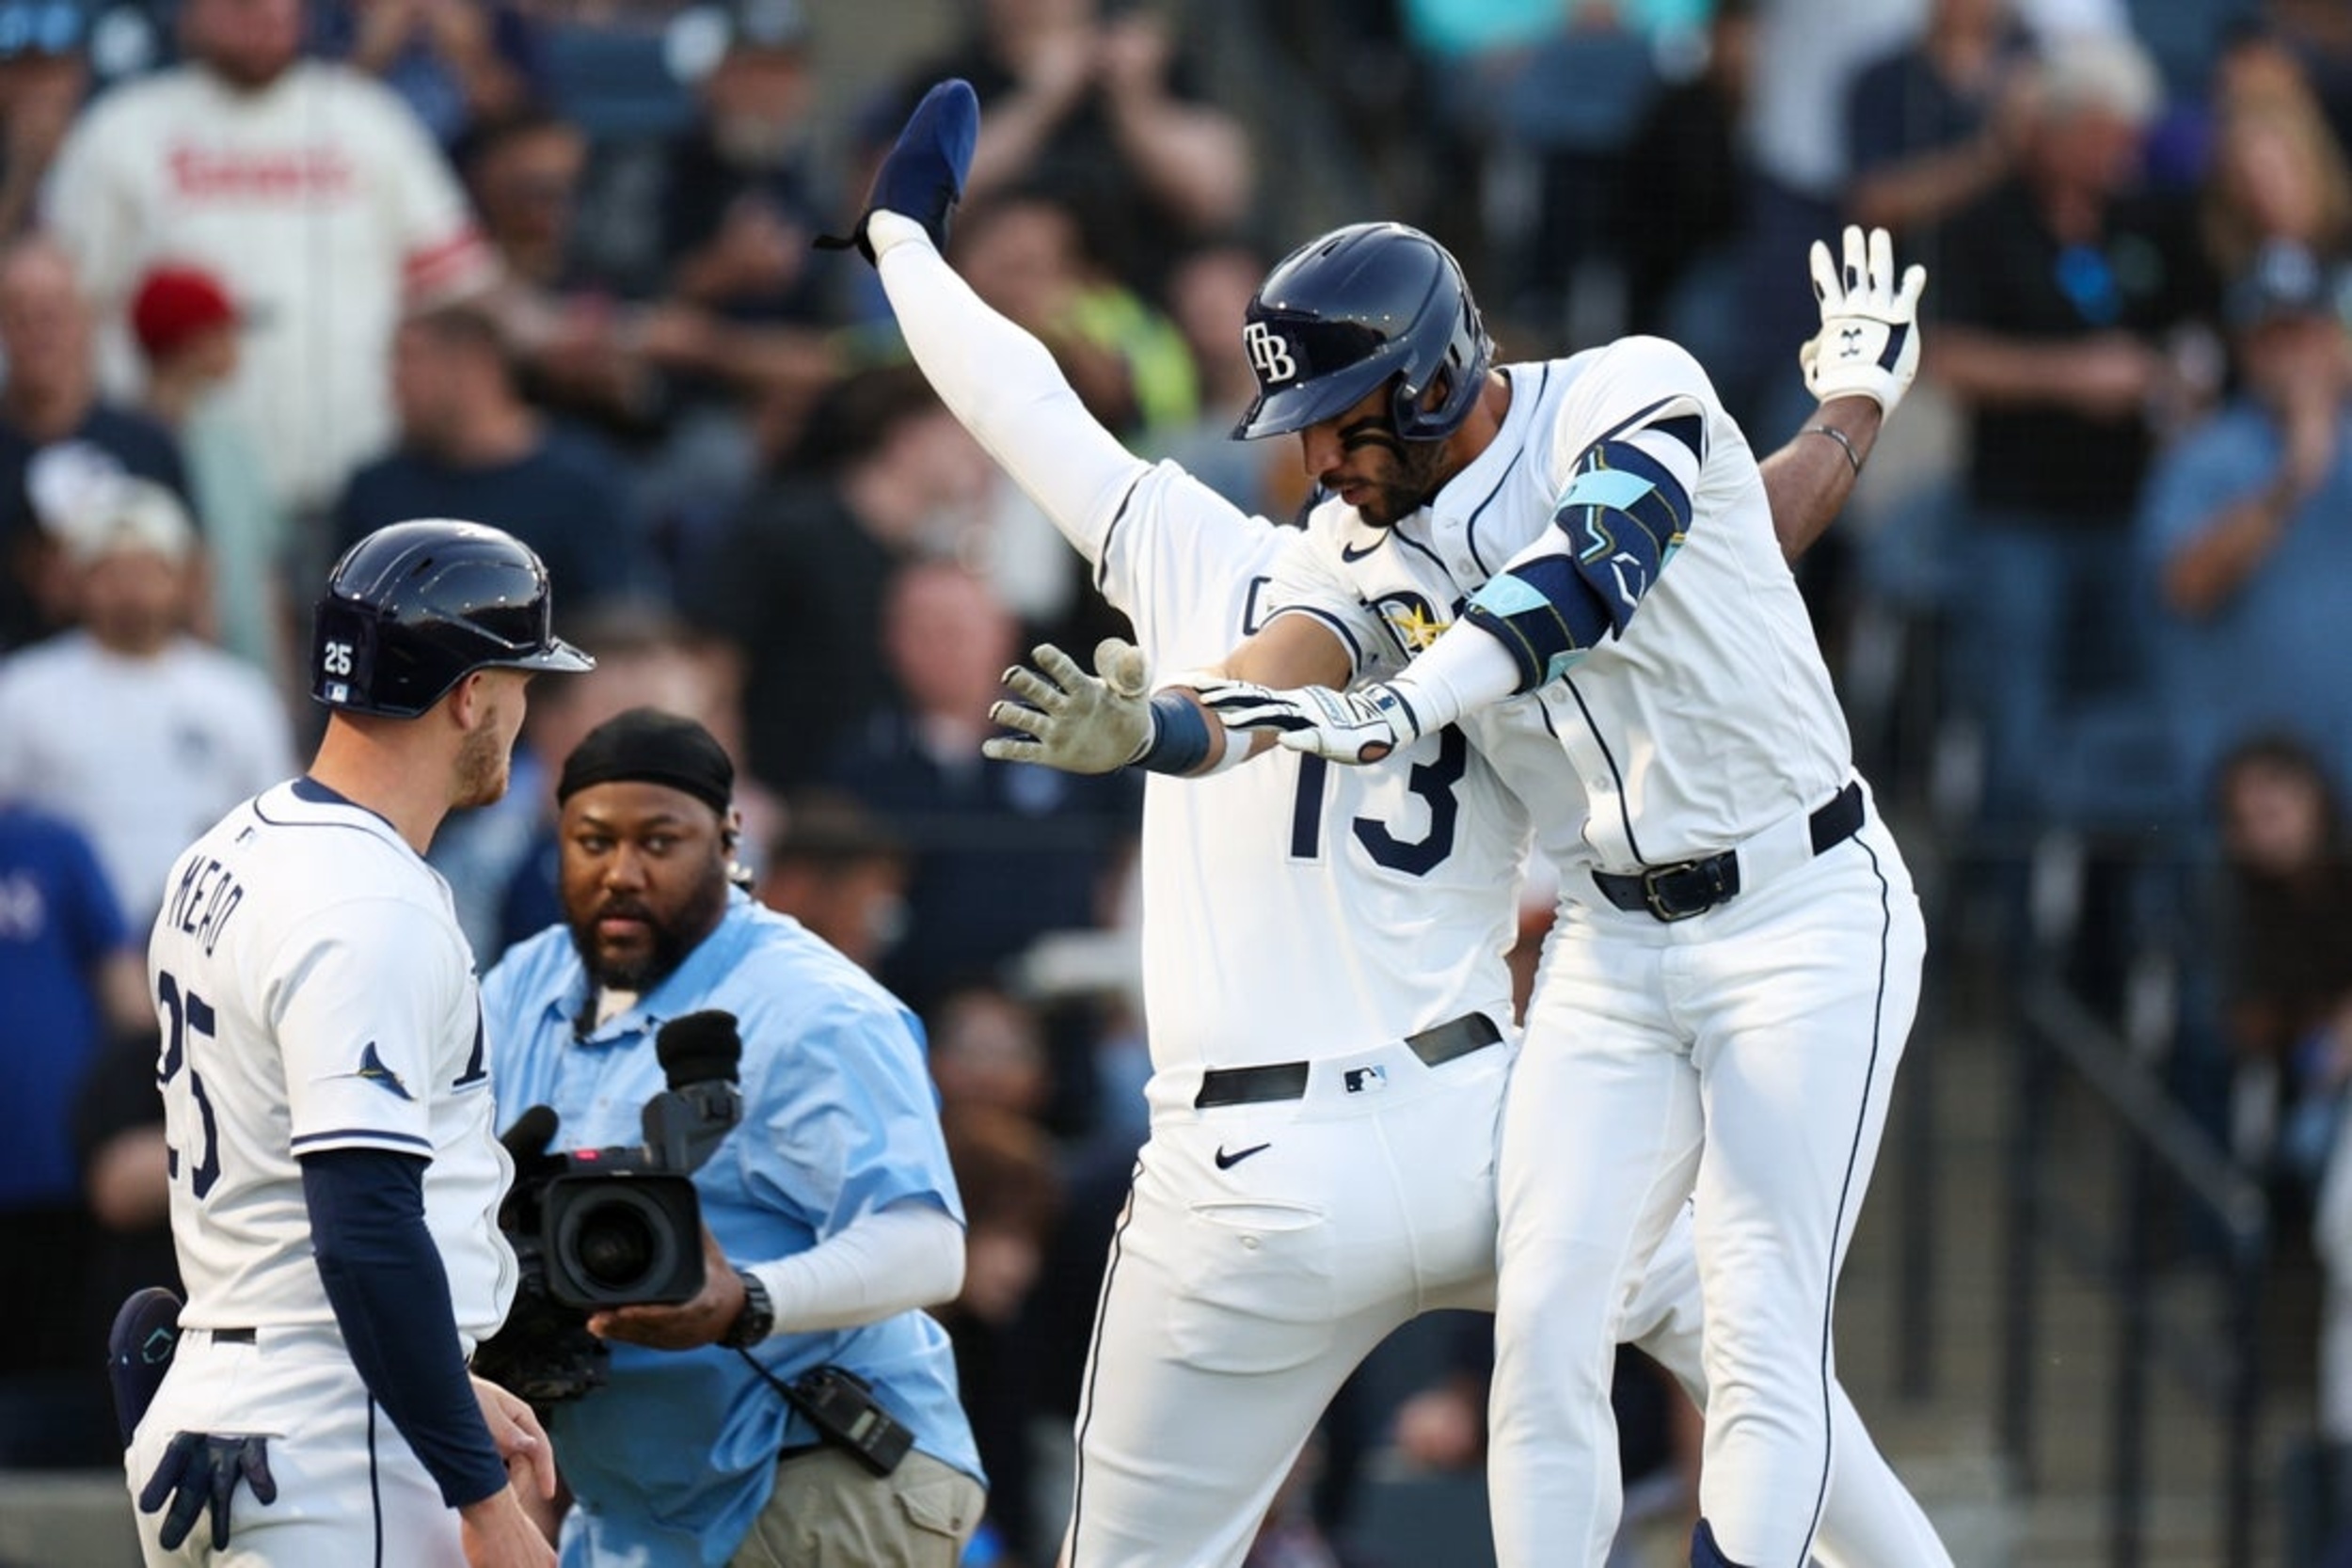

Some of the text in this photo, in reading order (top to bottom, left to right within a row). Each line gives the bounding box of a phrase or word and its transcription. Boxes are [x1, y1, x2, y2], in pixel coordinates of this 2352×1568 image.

[1244, 322, 1296, 383] TB
[325, 641, 353, 675] 25
[1291, 721, 1467, 877] 13
[167, 855, 244, 958] MEAD
[156, 970, 221, 1200] 25
